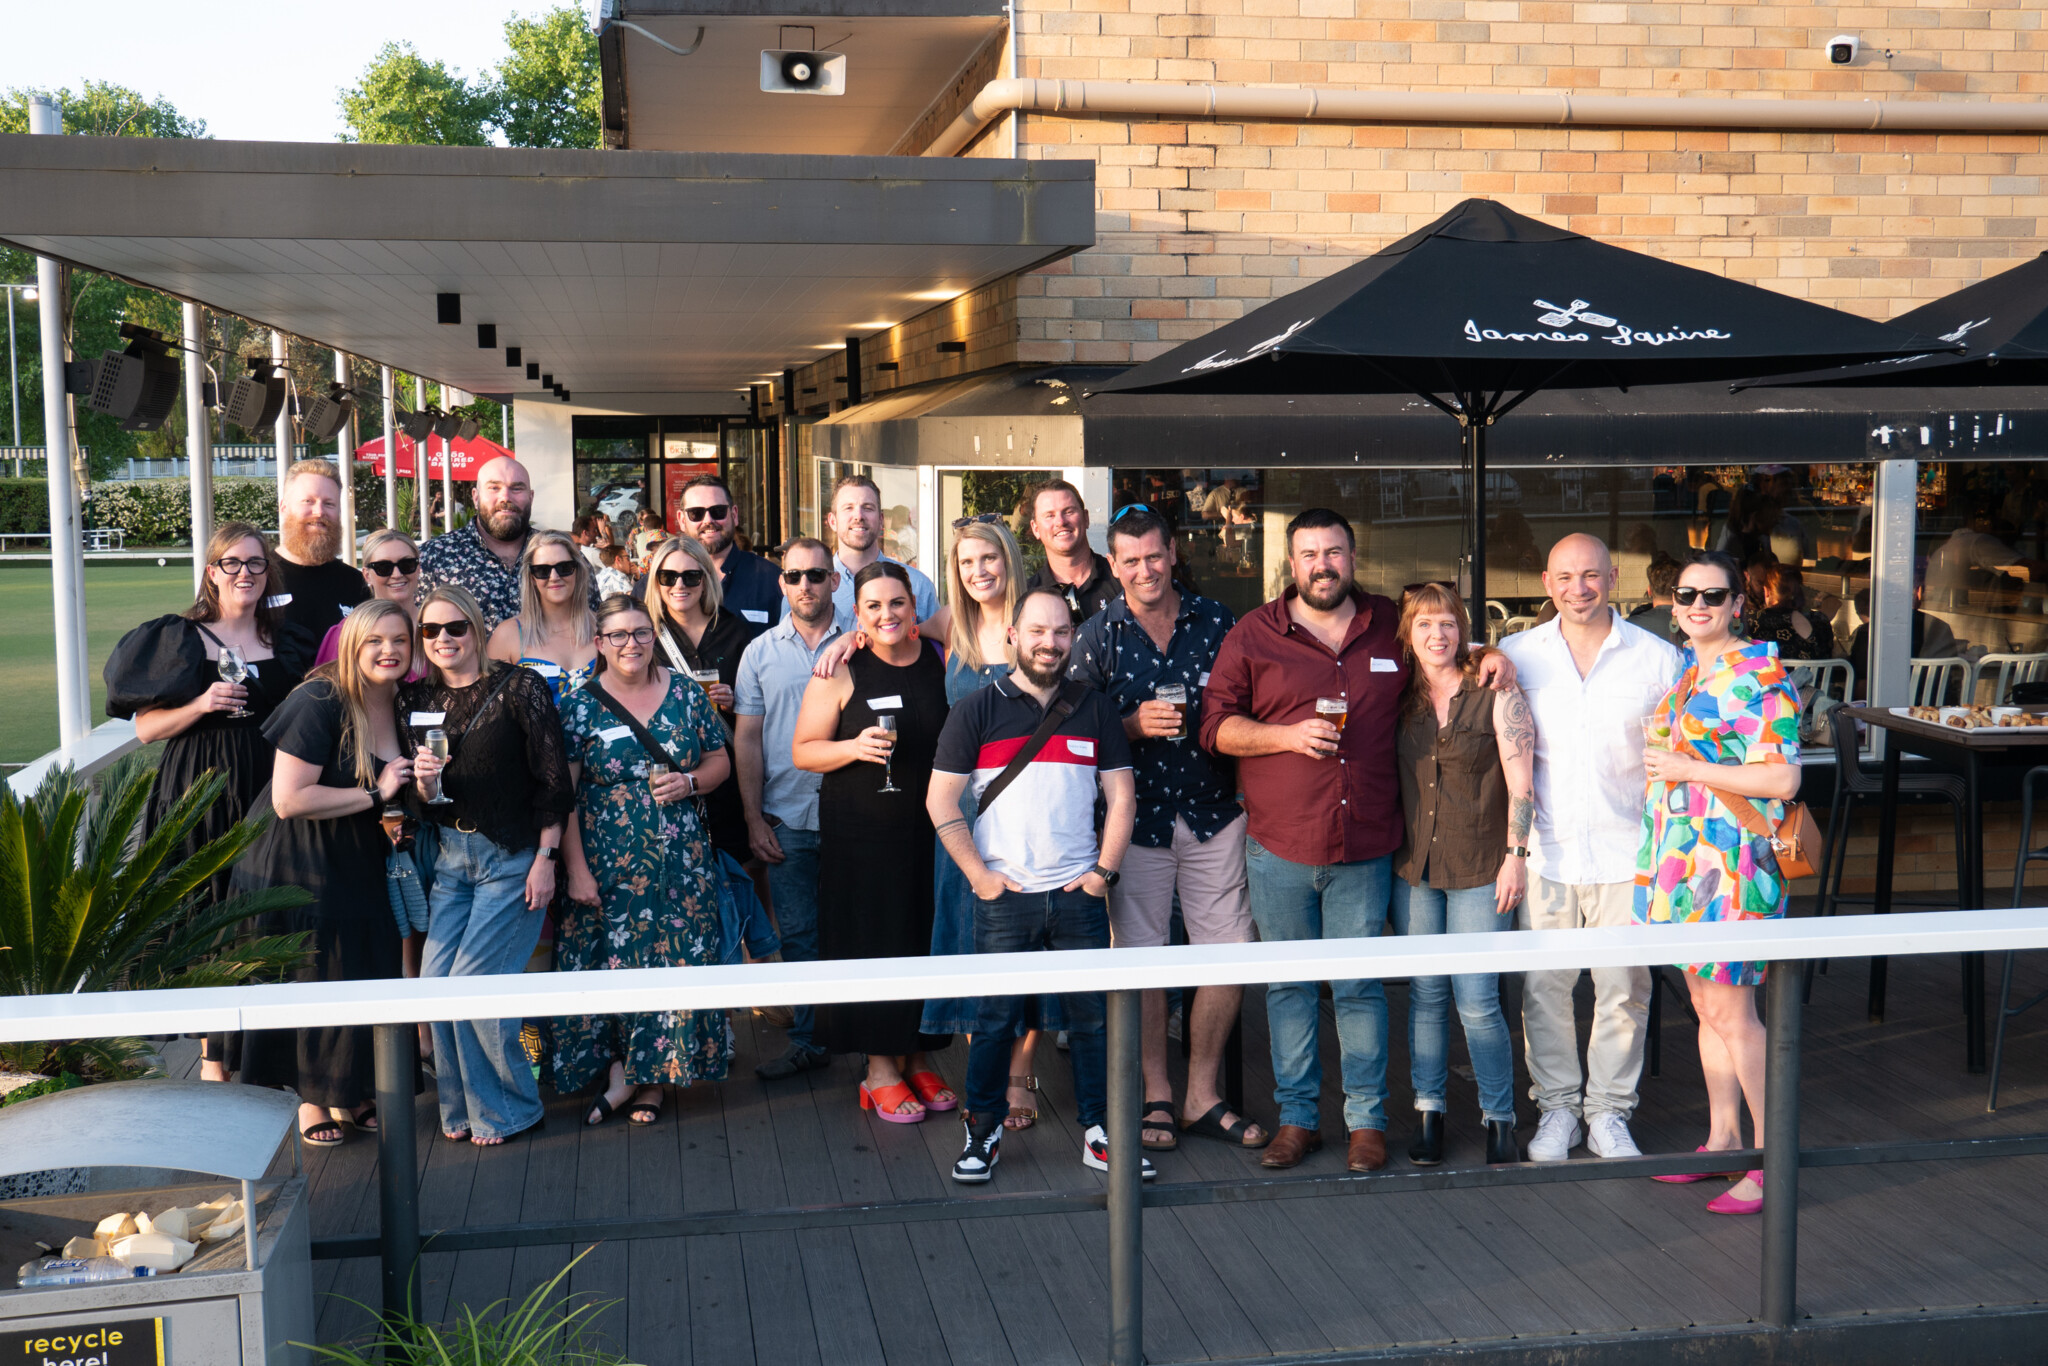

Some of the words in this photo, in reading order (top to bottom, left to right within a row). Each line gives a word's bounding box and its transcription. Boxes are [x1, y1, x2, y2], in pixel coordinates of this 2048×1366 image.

[1463, 309, 1589, 342] James
[1601, 325, 1731, 346] Squire
[24, 1328, 124, 1354] recycle
